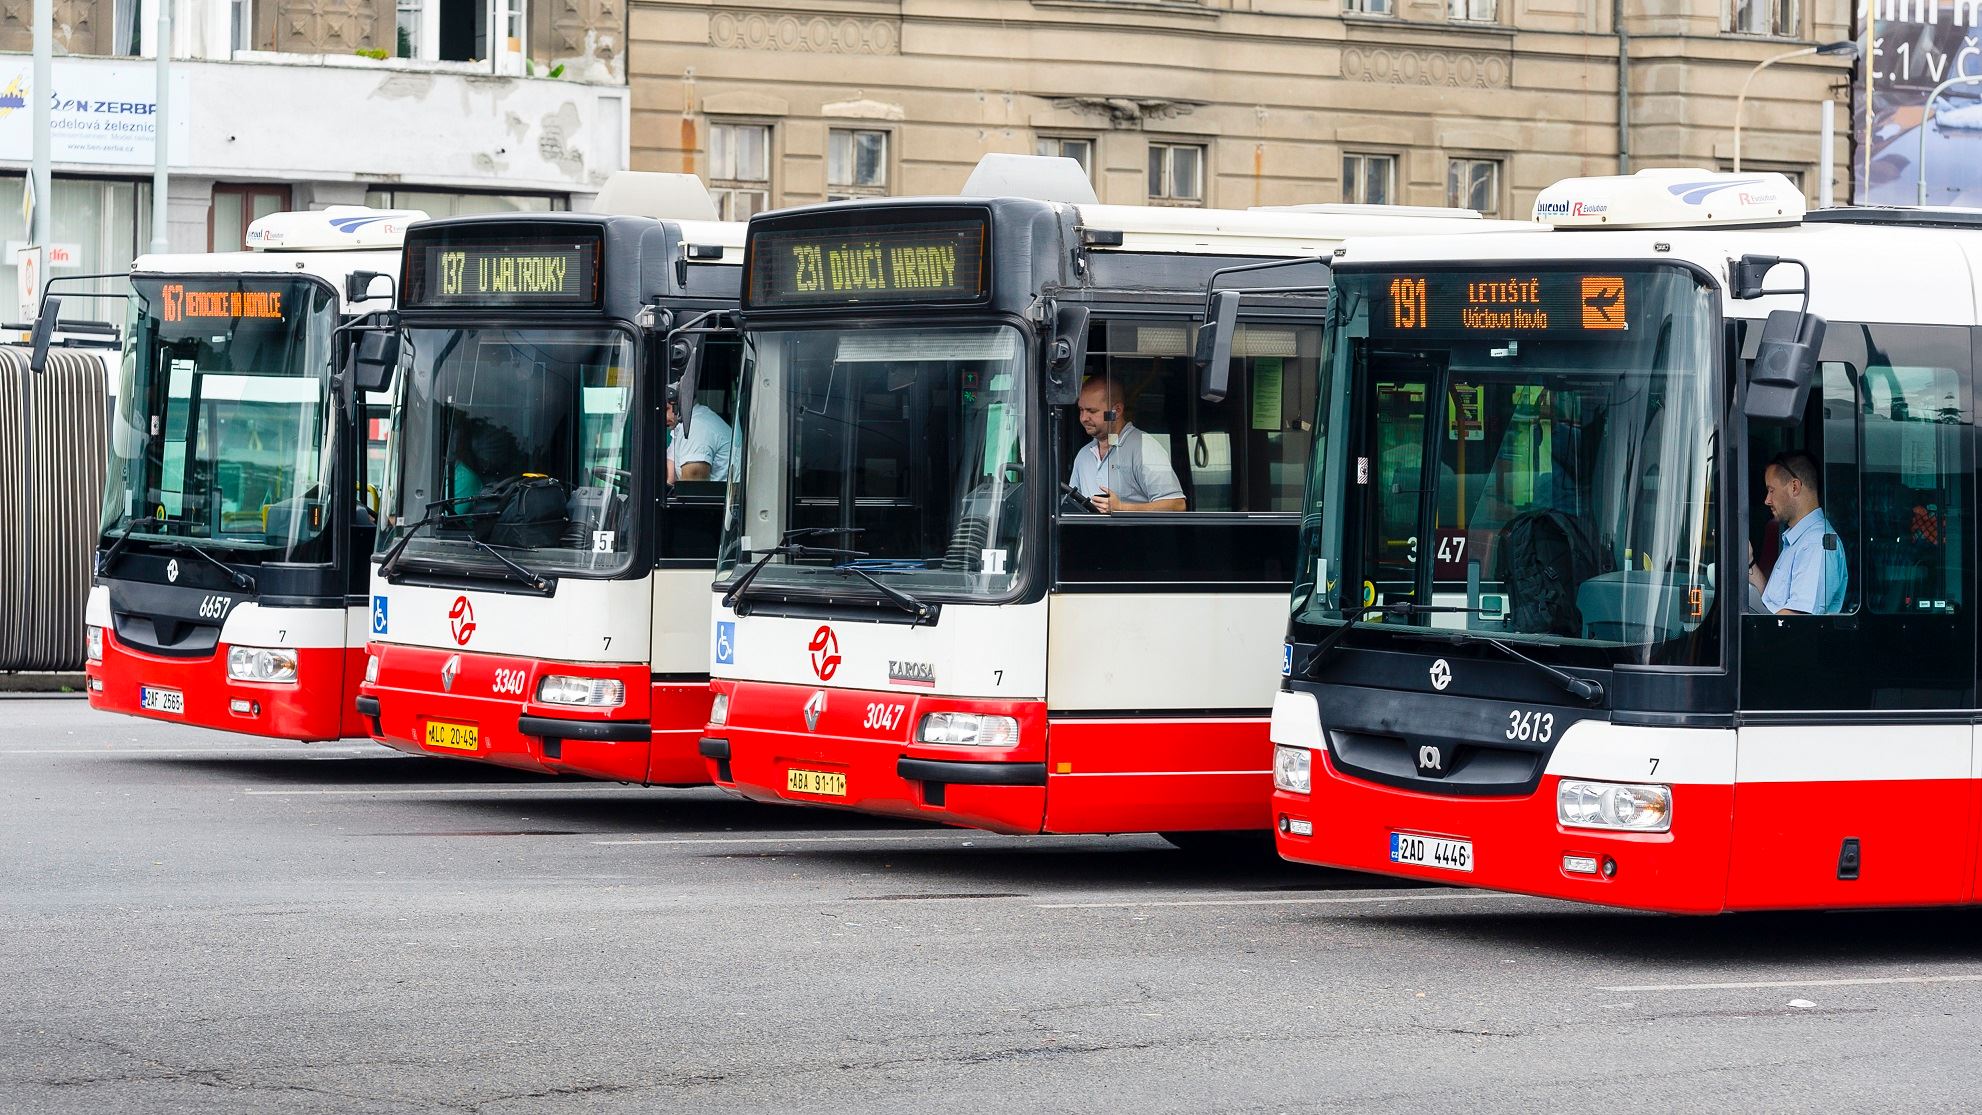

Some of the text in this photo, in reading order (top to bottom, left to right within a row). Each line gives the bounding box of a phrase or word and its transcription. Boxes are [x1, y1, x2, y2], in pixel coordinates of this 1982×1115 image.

[1926, 52, 1948, 82] v
[51, 119, 155, 132] odelová železnic
[441, 251, 566, 294] 137 U WALTROVKY
[793, 245, 825, 291] 231
[891, 245, 955, 288] HRADY
[162, 284, 184, 322] 167
[1390, 278, 1541, 328] 191 LETIŠTĚ
[1463, 306, 1548, 329] Václava Havla
[599, 533, 607, 551] 5
[1407, 536, 1466, 562] 347
[990, 551, 998, 572] 1
[199, 595, 231, 619] 6657
[1690, 587, 1703, 616] 9
[279, 630, 287, 643] 7
[603, 637, 612, 650] 7
[492, 668, 526, 695] 3340
[889, 660, 934, 680] KAROSA
[994, 670, 1003, 686] 7
[147, 691, 159, 707] 2AF
[163, 694, 180, 710] 2565
[863, 703, 905, 731] 3047
[1505, 709, 1554, 743] 3613
[430, 725, 445, 747] ALC
[1649, 758, 1660, 776] 7
[792, 772, 808, 790] ABA
[1401, 838, 1424, 862] 2AD
[1434, 842, 1467, 867] 4446
